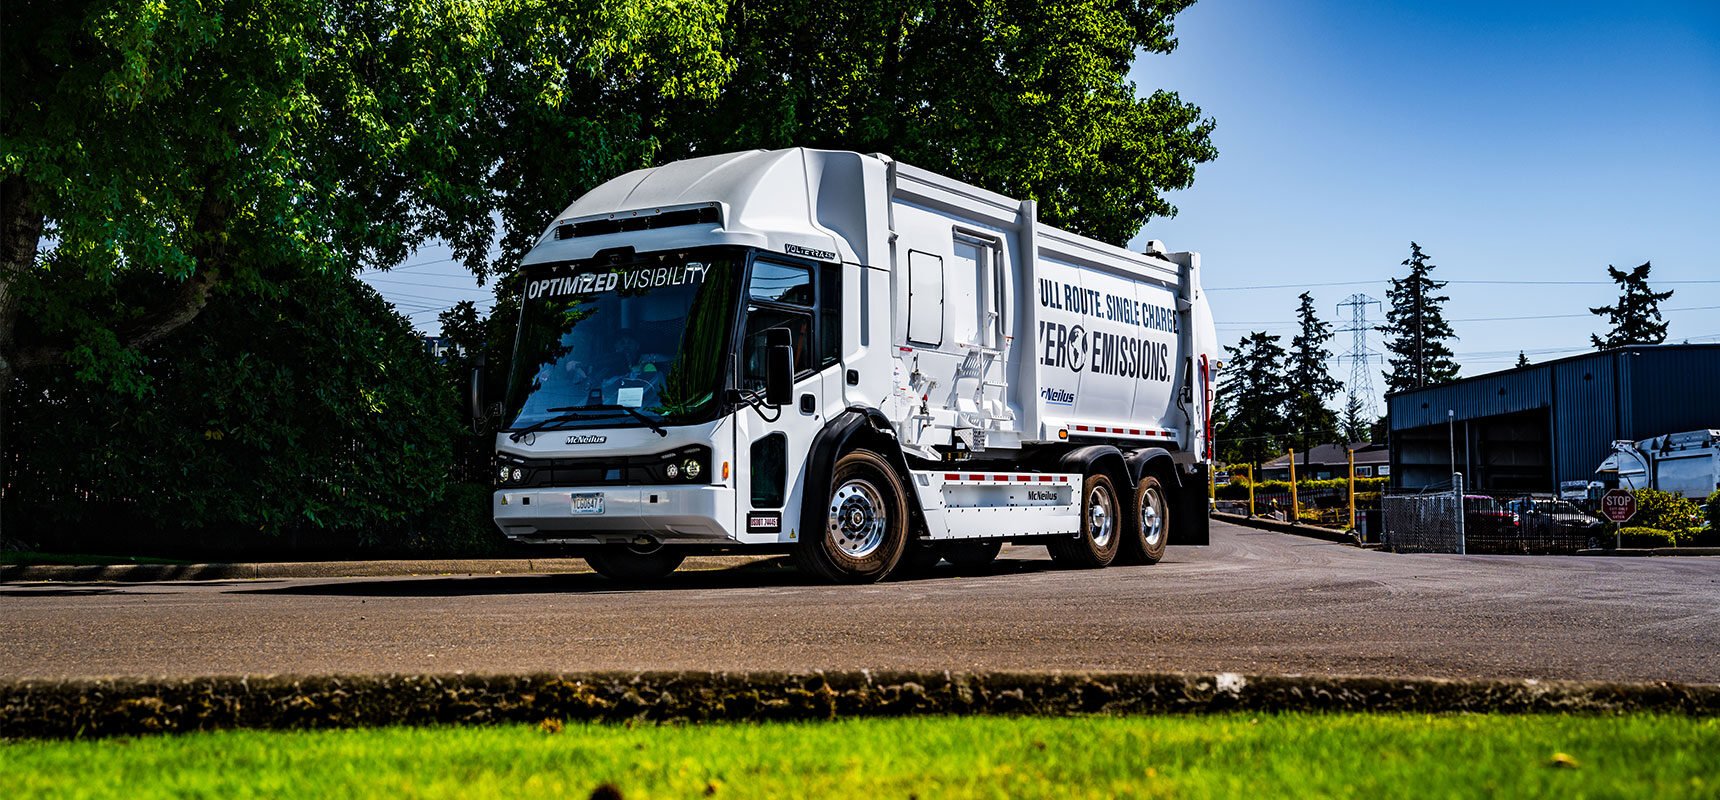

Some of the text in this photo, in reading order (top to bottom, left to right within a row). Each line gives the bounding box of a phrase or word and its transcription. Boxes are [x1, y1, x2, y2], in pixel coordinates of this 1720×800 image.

[786, 244, 824, 258] VOLTERRA
[528, 263, 711, 300] OPTIMIZED VISIBILITY
[1038, 277, 1062, 310] ULL
[1064, 283, 1104, 319] ROUTE.
[1106, 293, 1140, 326] SINGLE
[1091, 330, 1171, 383] EMISSIONS.
[1041, 387, 1075, 403] cNeilus
[566, 435, 607, 444] McNeilus
[1028, 490, 1058, 501] McNeilus
[1606, 495, 1631, 506] STOP
